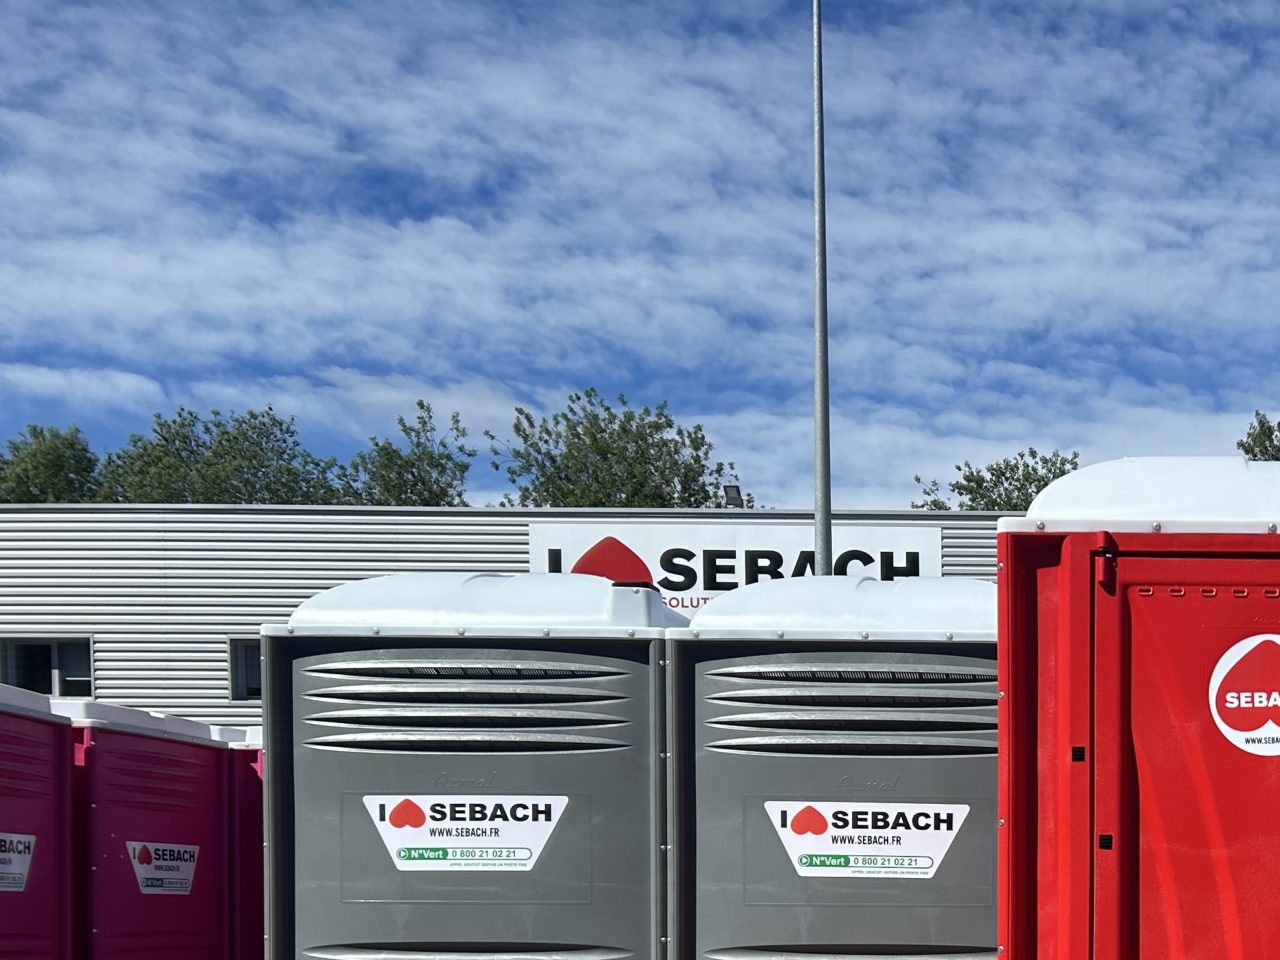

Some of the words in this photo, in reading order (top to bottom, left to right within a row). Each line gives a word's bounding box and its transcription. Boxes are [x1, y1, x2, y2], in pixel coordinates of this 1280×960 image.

[379, 803, 386, 822] I
[429, 803, 552, 822] SEBACH
[780, 810, 787, 828] I
[831, 810, 954, 831] SEBACH
[429, 827, 500, 837] WWW.SEBACH.FR
[831, 835, 902, 845] WWW.SEBACH.FR
[153, 848, 195, 863] SEBACH
[411, 849, 443, 859] N°Vert
[452, 850, 458, 858] 0
[460, 850, 476, 858] 800
[478, 850, 489, 858] 21
[493, 850, 503, 858] 02
[506, 850, 516, 858] 21
[812, 856, 845, 866] N°Vert
[854, 858, 859, 866] 0
[862, 858, 878, 866] 800
[880, 858, 890, 866] 21
[894, 858, 904, 866] 02
[908, 858, 918, 866] 21
